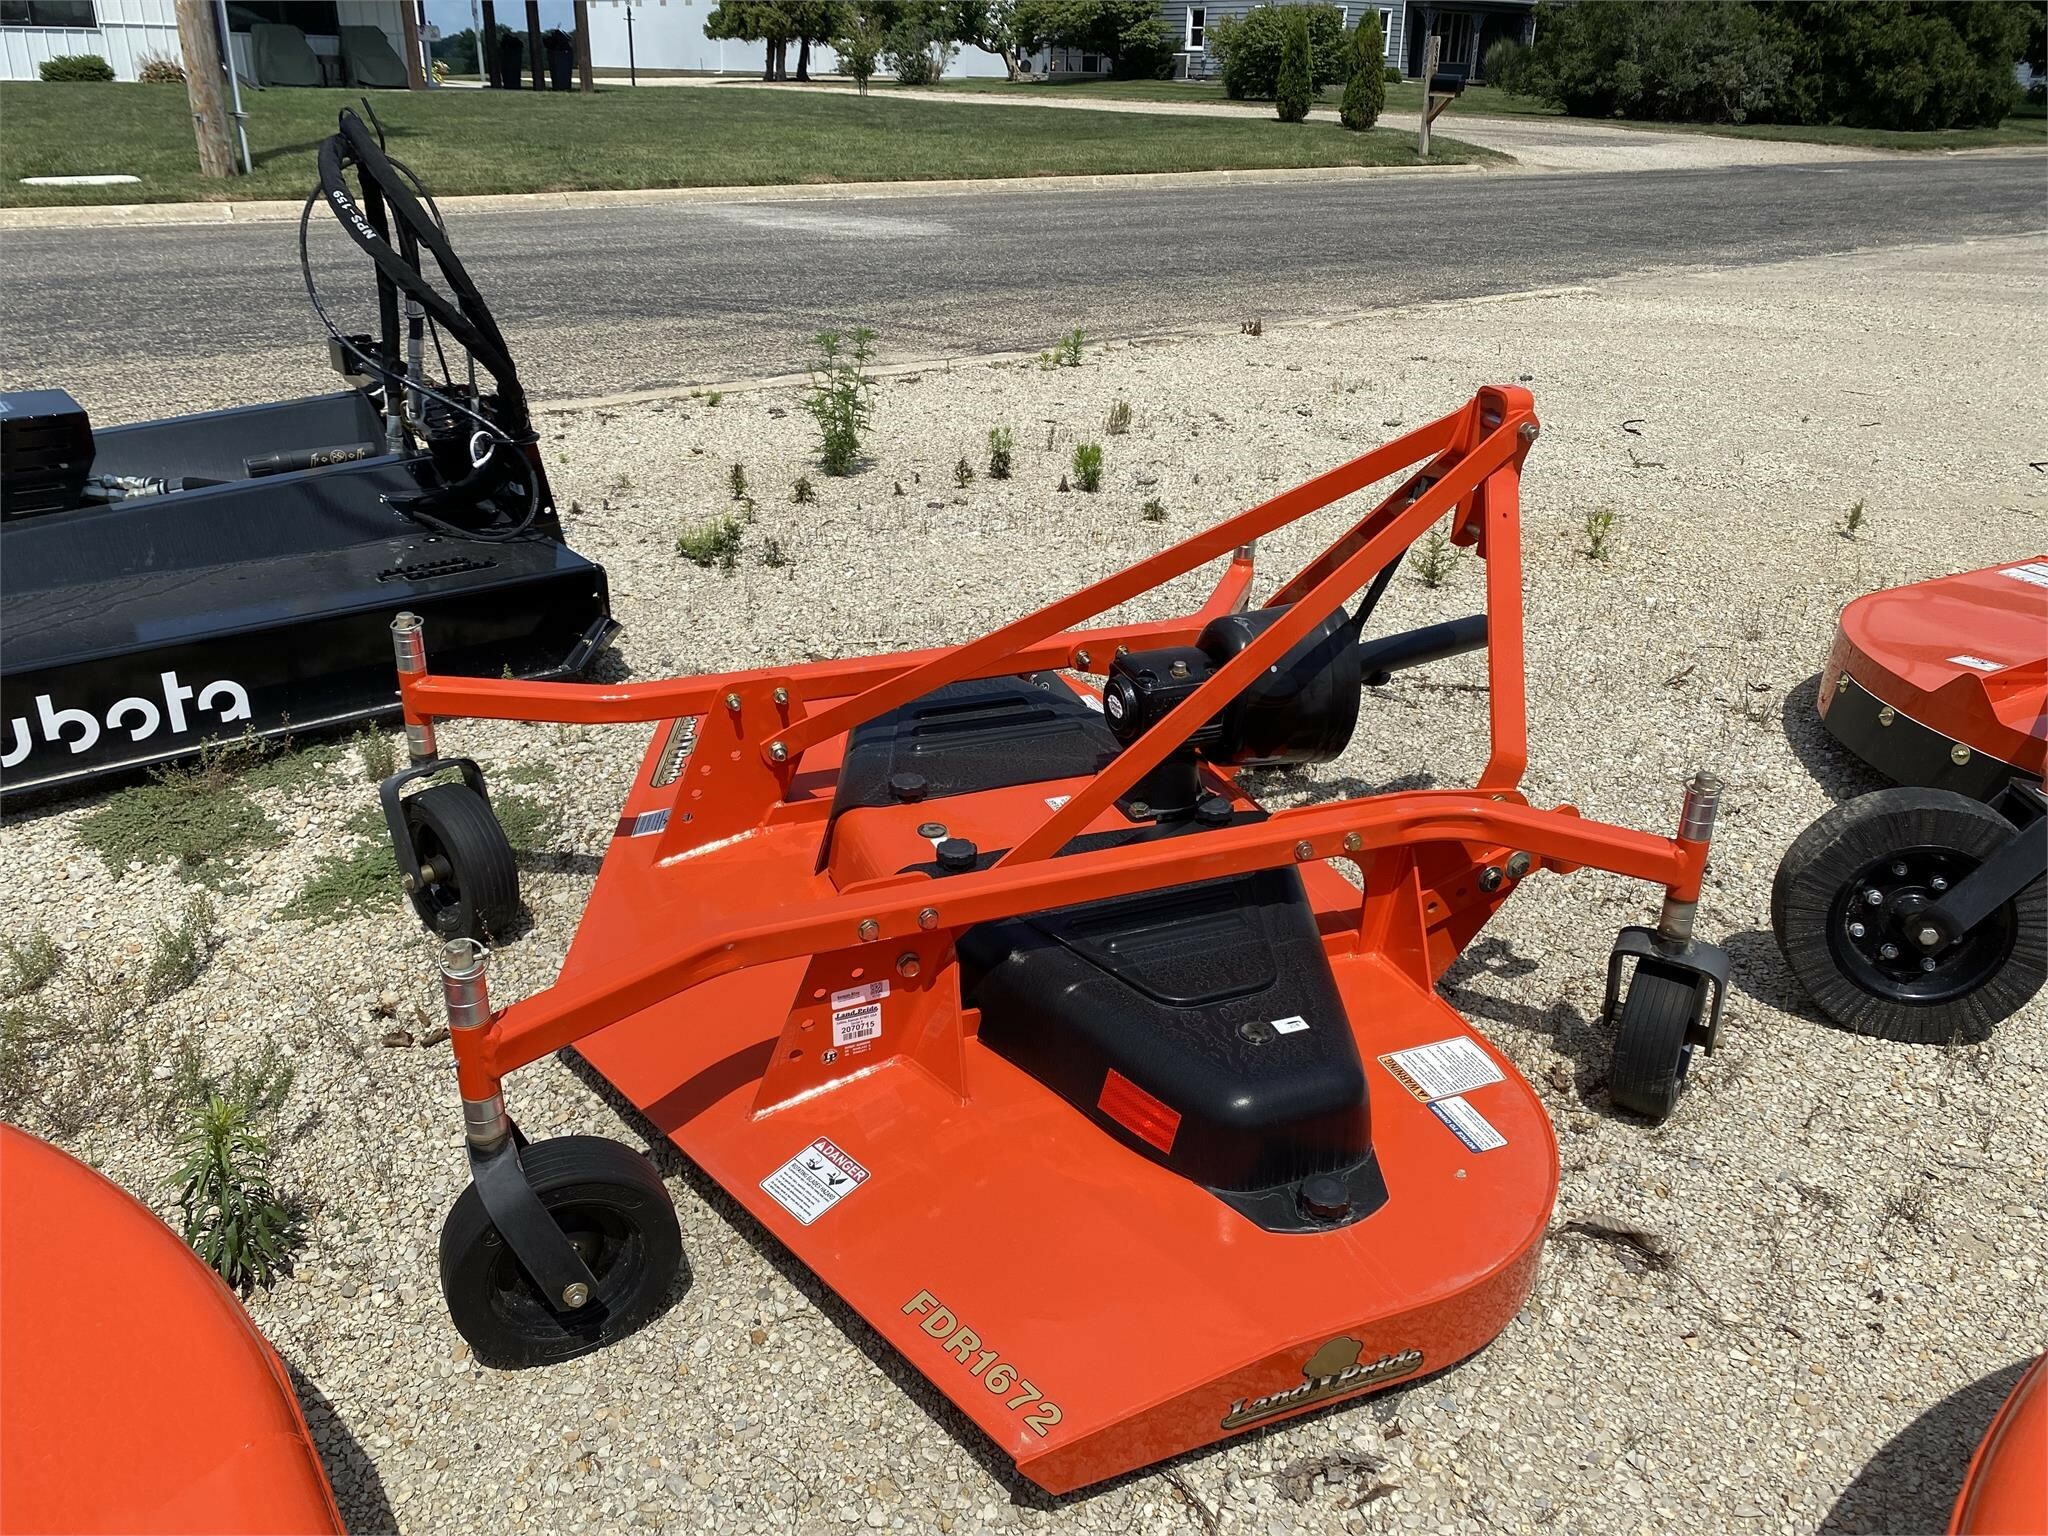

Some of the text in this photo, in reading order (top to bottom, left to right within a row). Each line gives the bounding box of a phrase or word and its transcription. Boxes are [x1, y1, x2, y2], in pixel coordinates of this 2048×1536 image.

[333, 190, 377, 239] NPS-159
[841, 1020, 875, 1034] 2070715
[1384, 1058, 1420, 1092] WARNING
[1455, 1129, 1478, 1150] NOTICE
[823, 1145, 866, 1182] DANGER
[901, 1289, 1063, 1438] FDR1672
[1227, 1349, 1422, 1420] Land Pride
